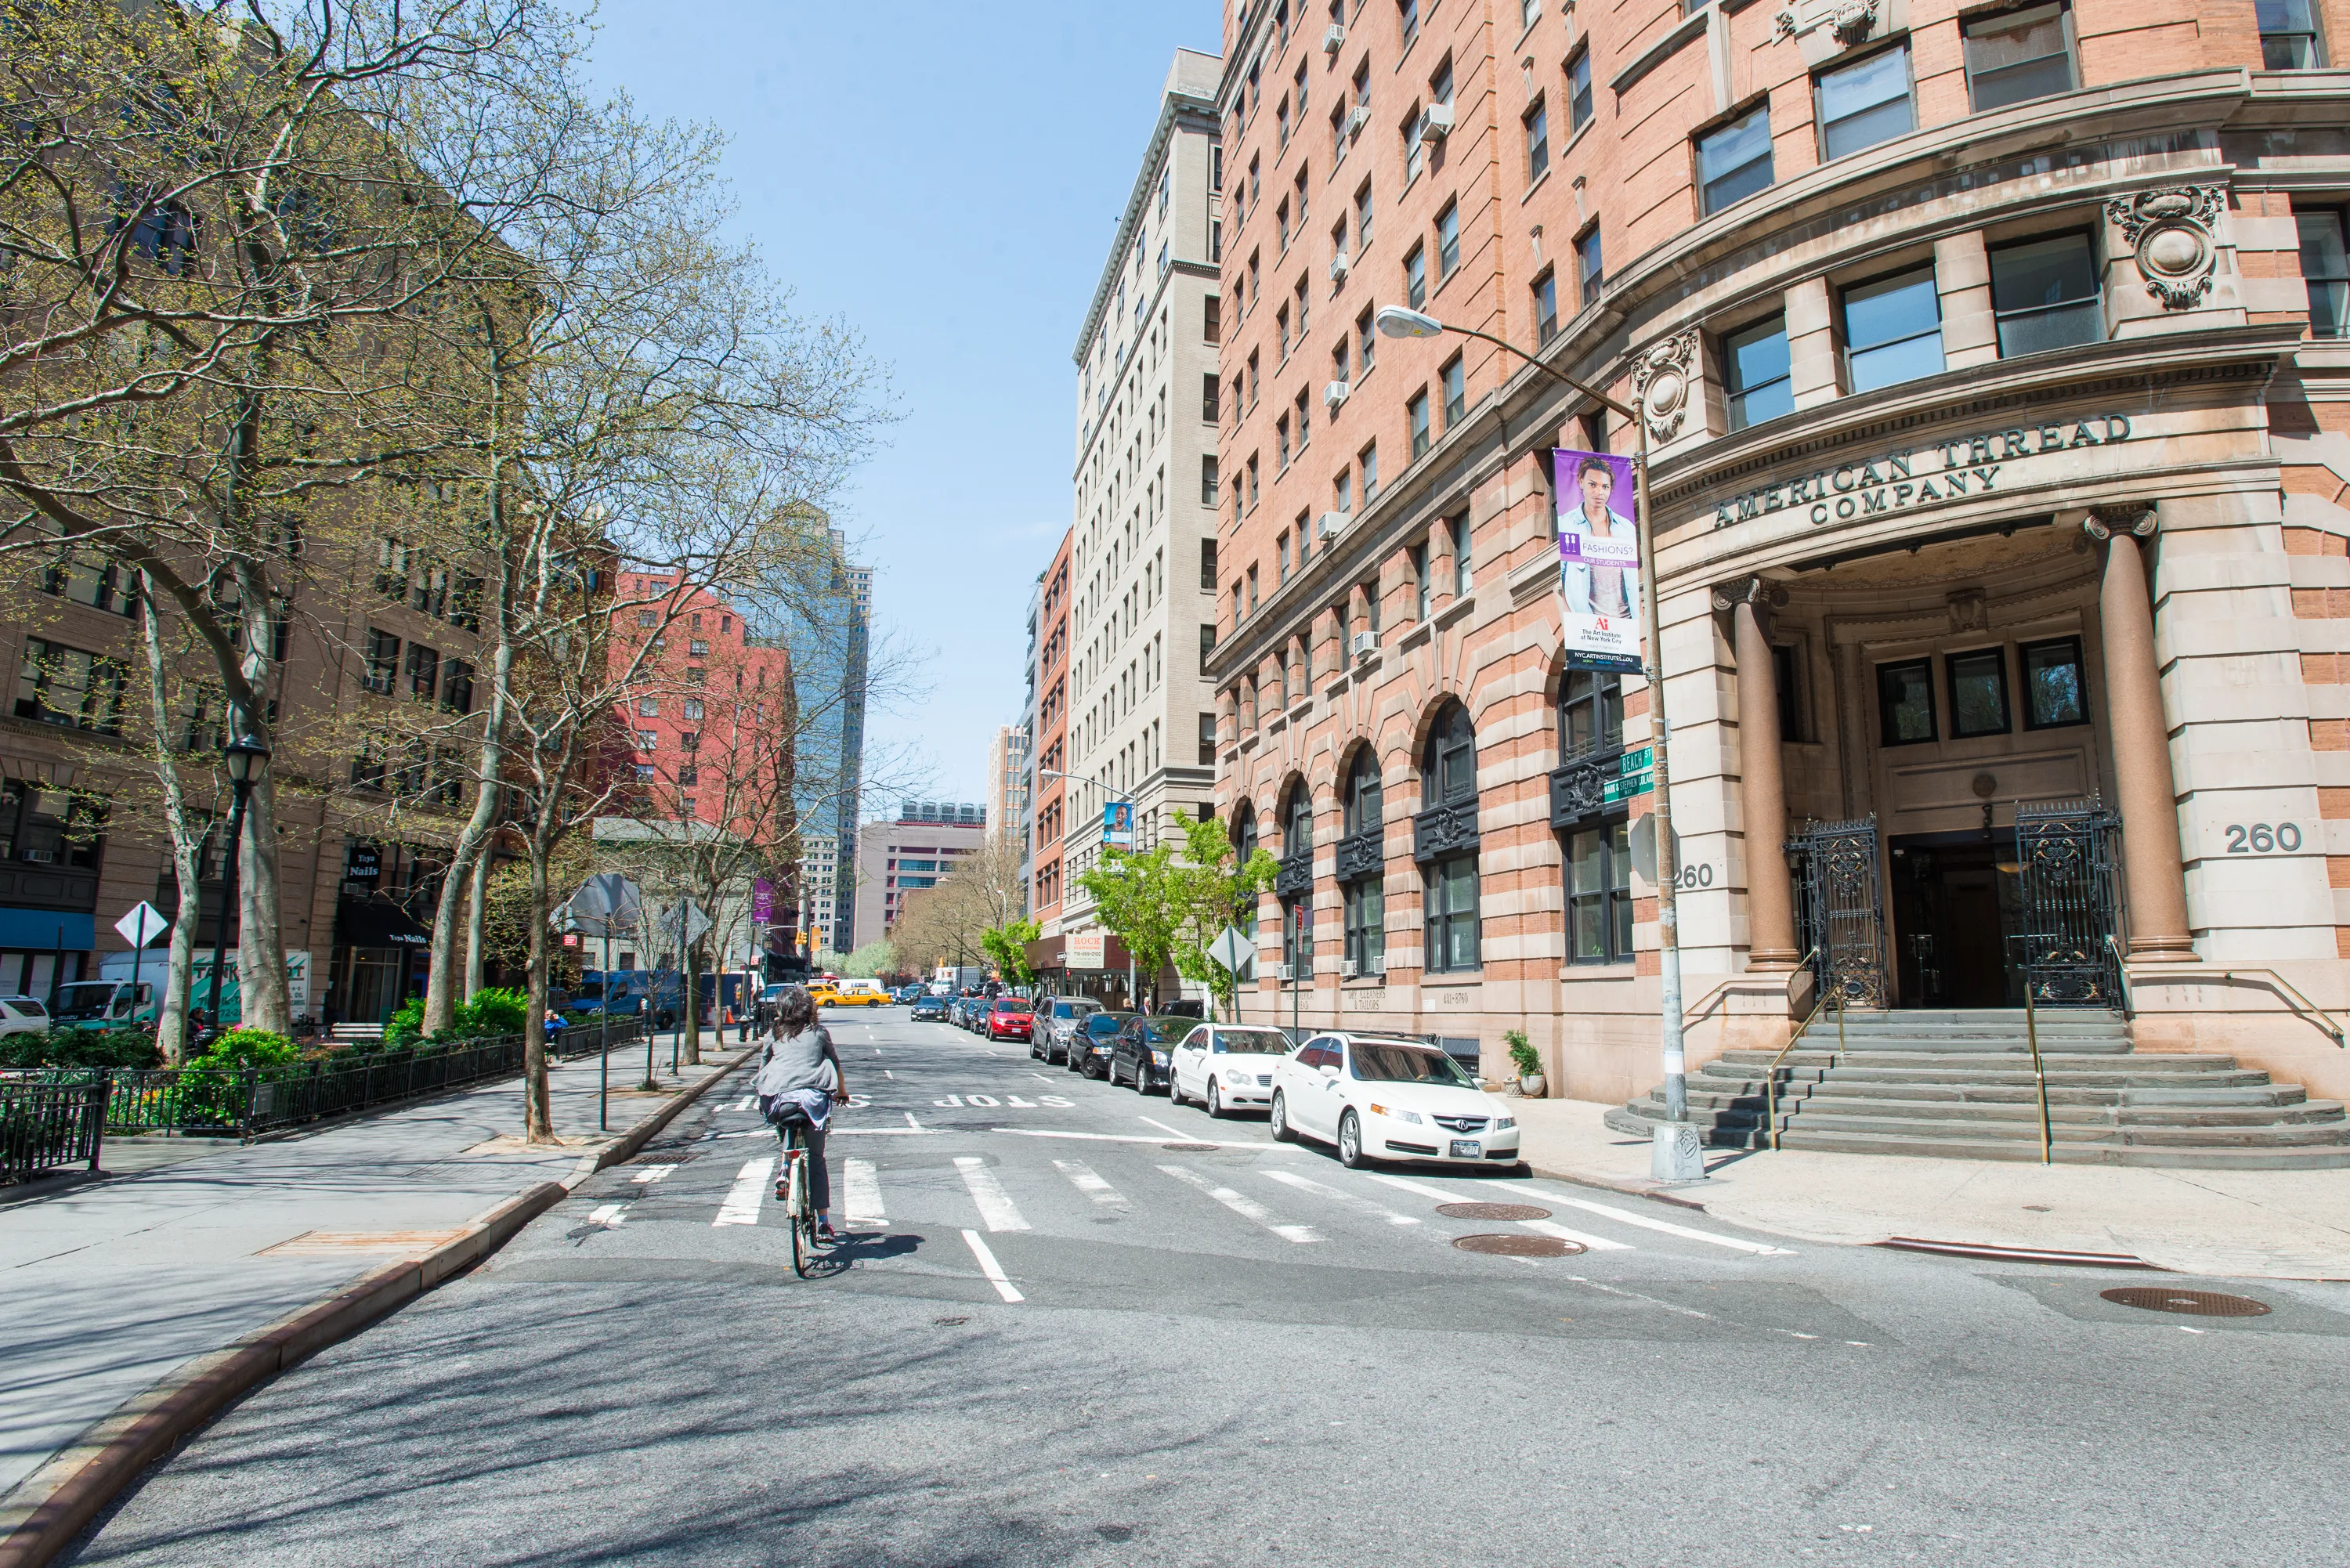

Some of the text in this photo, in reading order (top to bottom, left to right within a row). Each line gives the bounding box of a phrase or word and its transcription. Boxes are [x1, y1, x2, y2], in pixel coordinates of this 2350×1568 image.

[1714, 414, 2131, 529] AMERICAN THREAD
[1810, 465, 2000, 525] COMPANY
[1582, 543, 1634, 555] FASHIONS?
[1574, 652, 1633, 662] NYC.ARTINSTITUTES.EDU
[1622, 749, 1651, 772] BEACH ST
[1604, 783, 1615, 795] MARK
[1616, 782, 1620, 791] &
[1619, 778, 1638, 791] STEPHEN
[2225, 822, 2301, 853] 260
[349, 866, 378, 876] Nails
[403, 934, 427, 944] Nails
[1348, 988, 1386, 999] DRY CLEANERS
[1444, 992, 1469, 1004] 431-8760
[1359, 1000, 1379, 1010] TAILORS
[932, 1094, 1076, 1107] STOP
